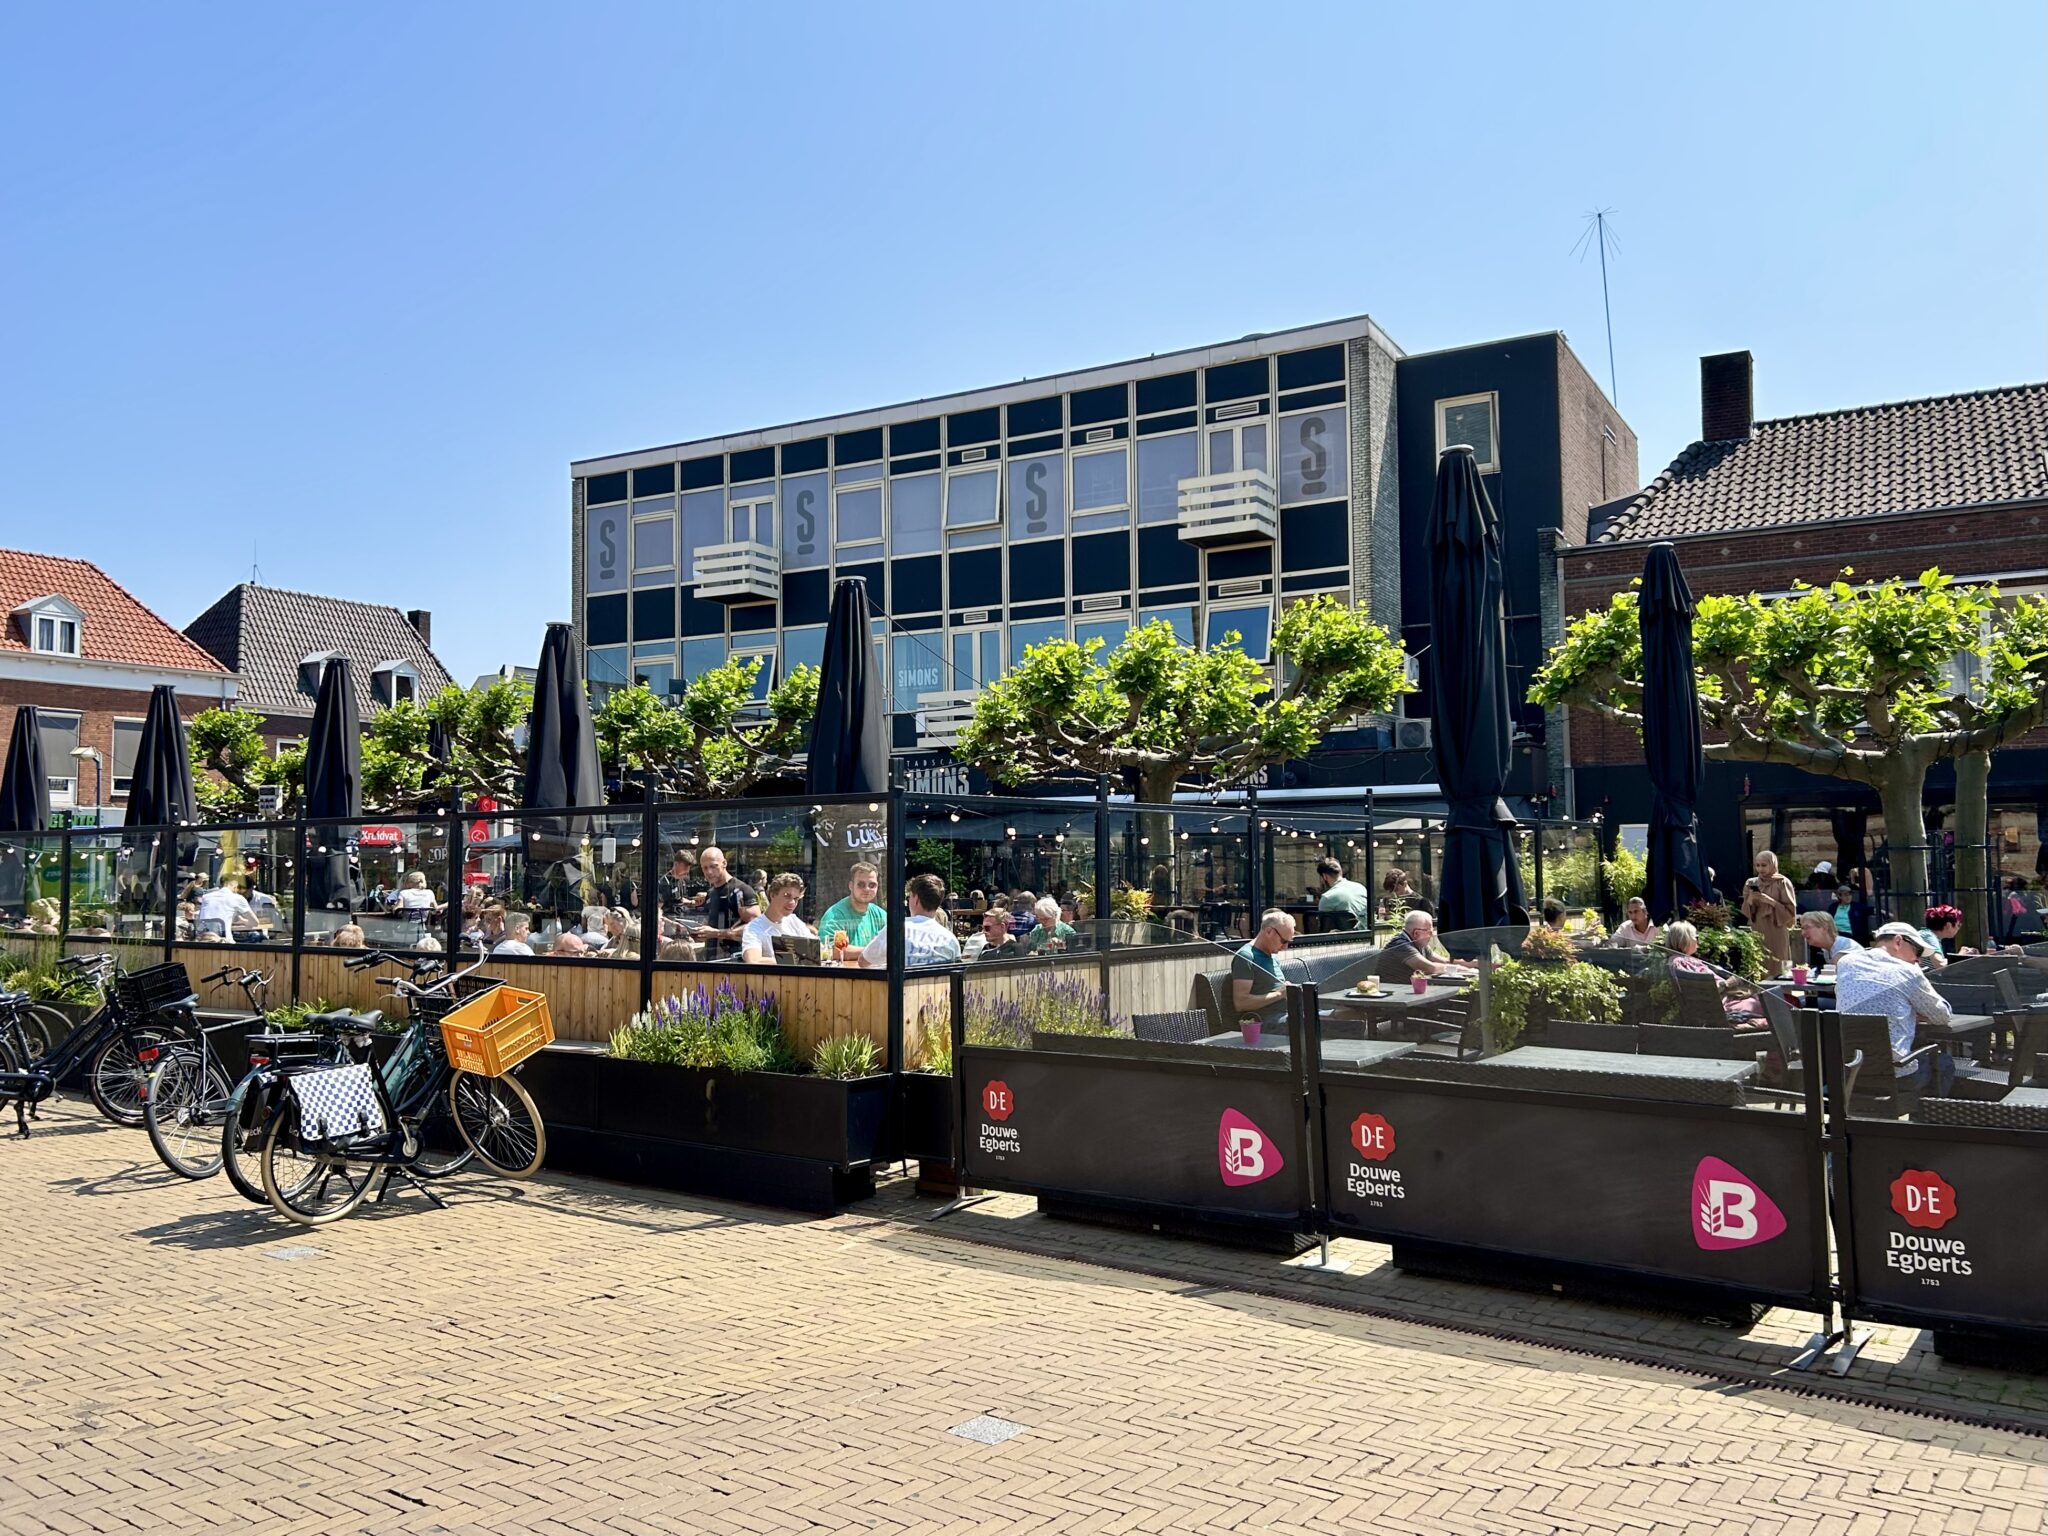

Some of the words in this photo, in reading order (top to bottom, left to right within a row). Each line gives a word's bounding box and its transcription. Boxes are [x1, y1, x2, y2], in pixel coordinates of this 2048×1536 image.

[1301, 416, 1327, 480] S
[1026, 462, 1048, 520] S
[797, 490, 815, 542] S
[600, 519, 616, 568] S
[898, 667, 939, 687] SIMONS
[904, 767, 970, 795] IMONS
[979, 1136, 1020, 1153] Egberts
[981, 1123, 1018, 1139] Douwe
[1230, 1127, 1264, 1177] B
[1349, 1162, 1401, 1183] Douwe
[1347, 1177, 1405, 1199] Egberts
[1709, 1179, 1758, 1240] B
[1889, 1231, 1966, 1255] Douwe
[1886, 1249, 1973, 1276] Egberts
[1921, 1278, 1940, 1287] 1753
